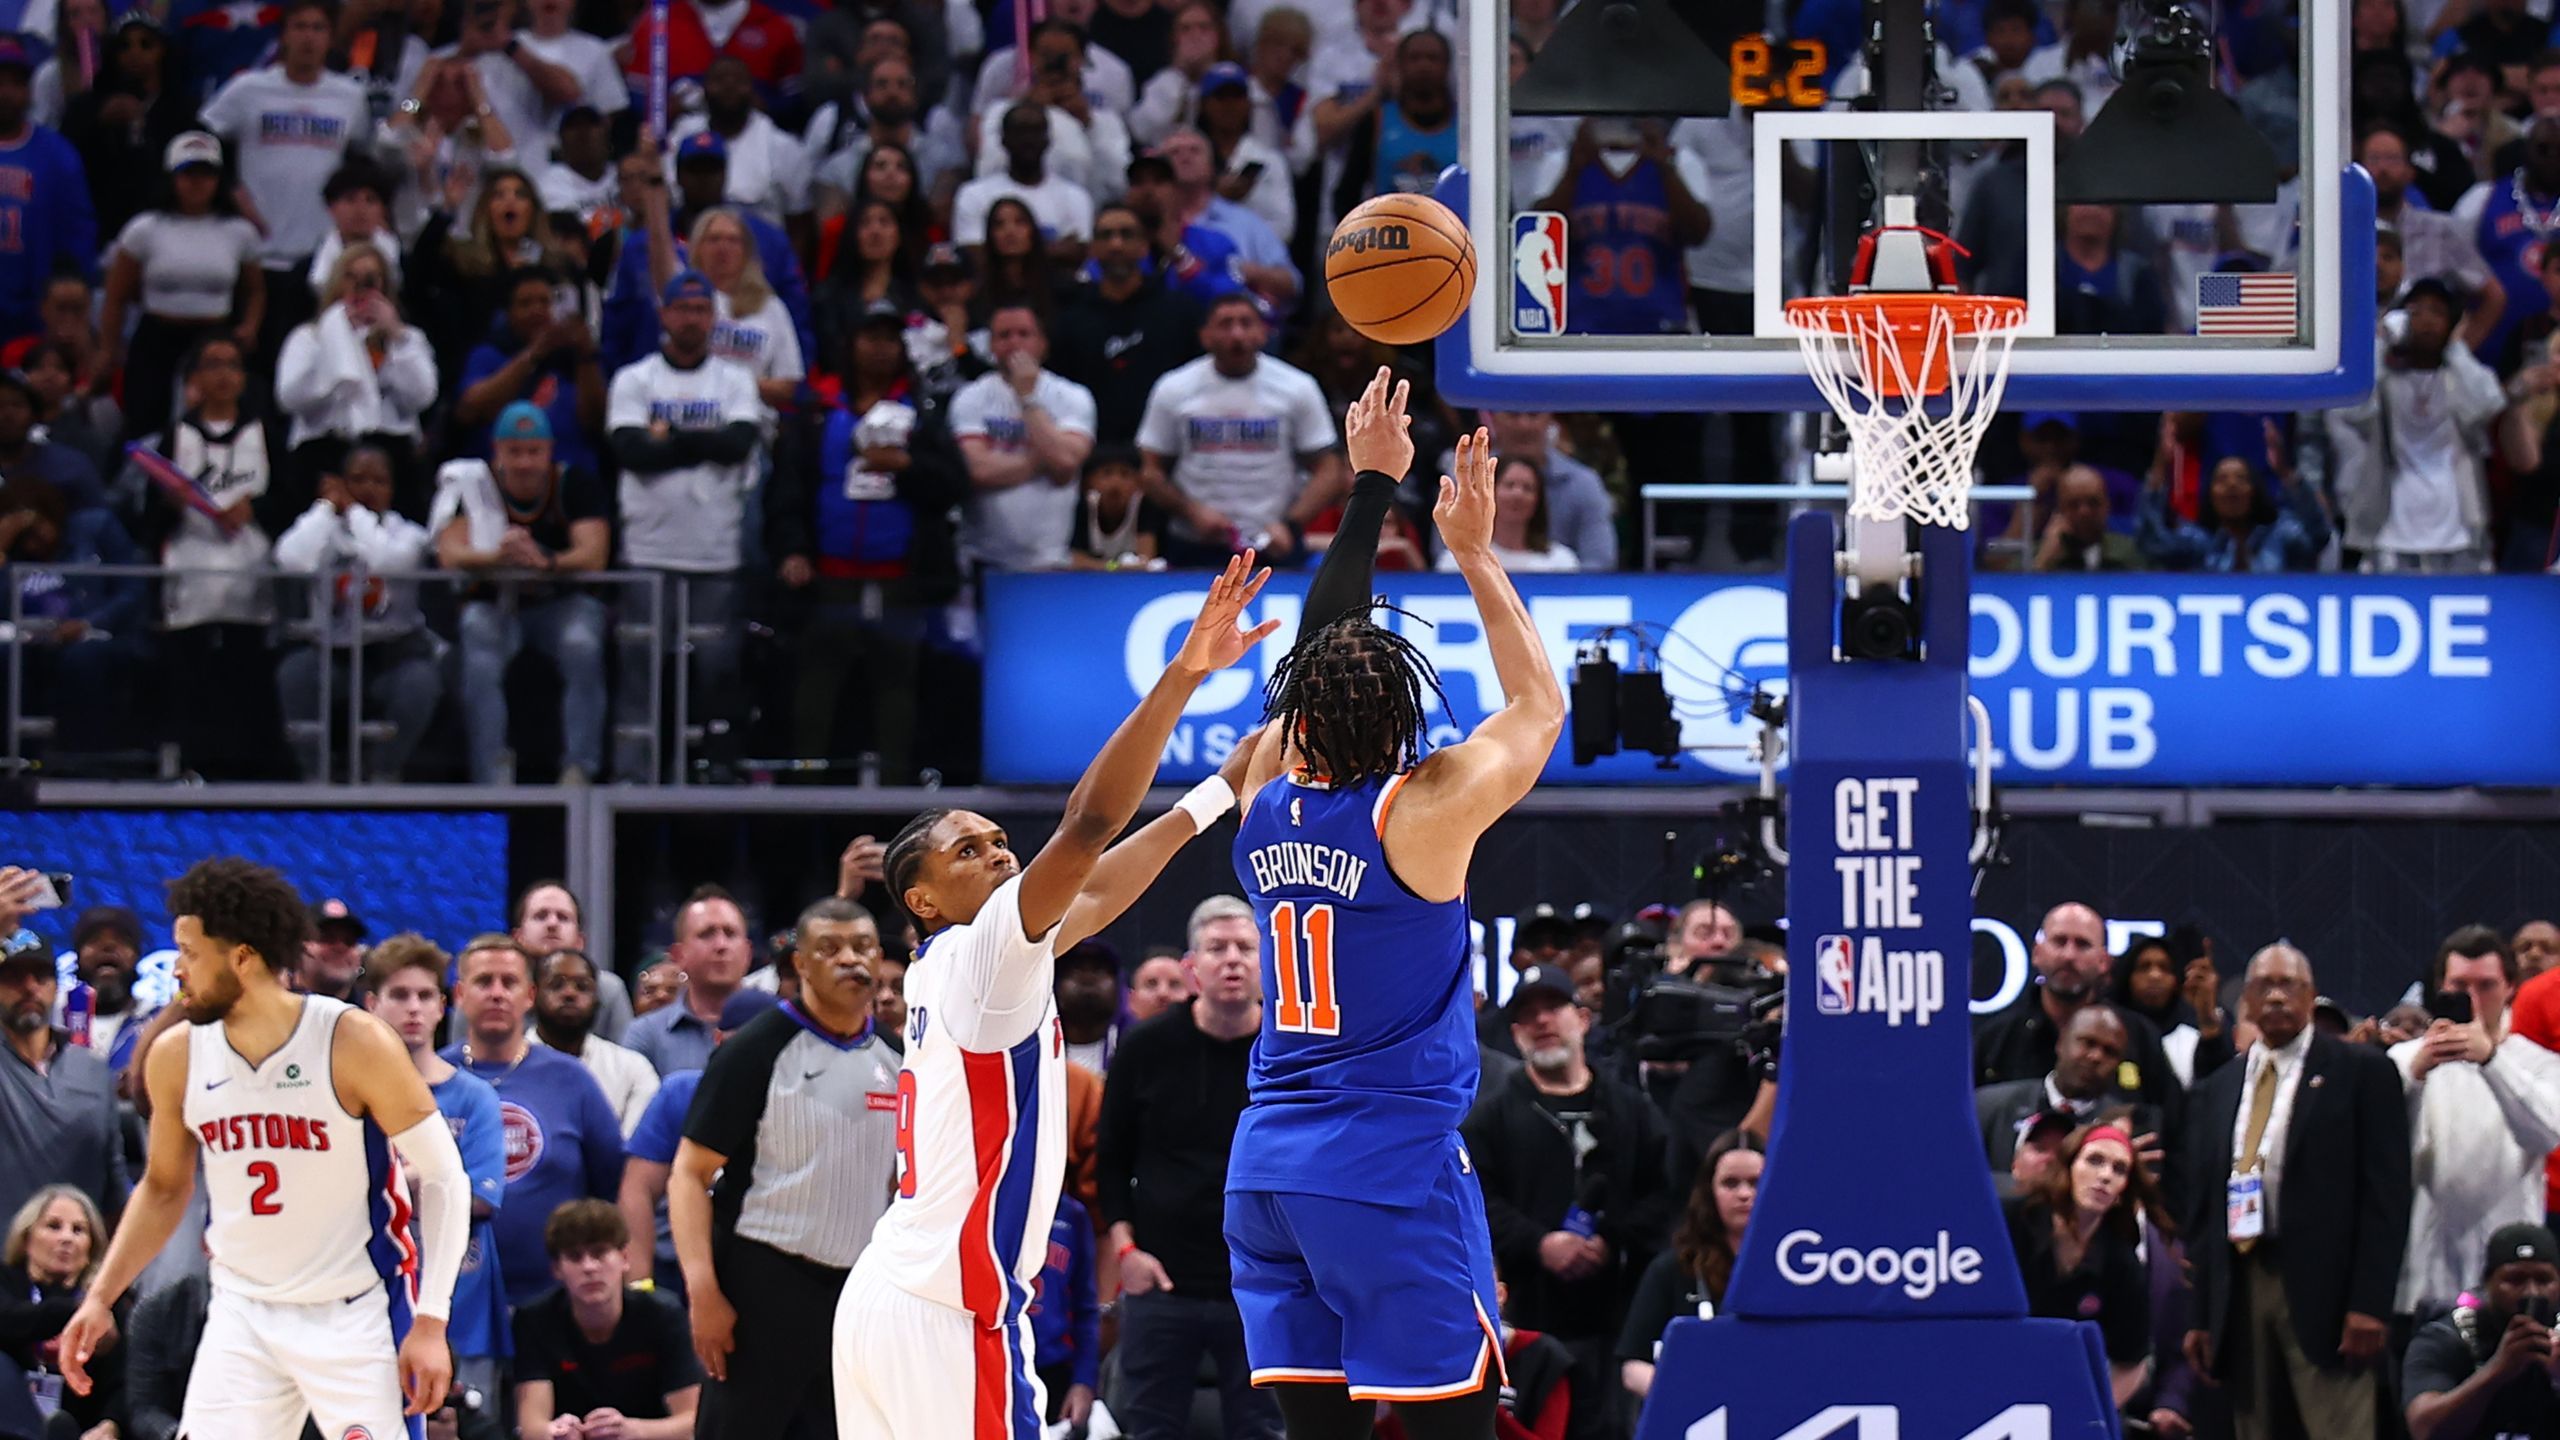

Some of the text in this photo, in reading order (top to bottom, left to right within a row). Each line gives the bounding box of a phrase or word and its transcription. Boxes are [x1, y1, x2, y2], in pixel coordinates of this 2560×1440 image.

[1328, 225, 1410, 258] Wilson
[1582, 244, 1656, 297] 30
[1968, 593, 2491, 678] OURTSIDE
[1968, 687, 2157, 769] UB
[1834, 778, 1919, 851] GET
[1249, 841, 1368, 901] BRUNSON
[1834, 855, 1923, 929] THE
[1270, 900, 1341, 1036] 11
[1857, 936, 1944, 1026] App
[198, 1113, 332, 1155] PISTONS
[247, 1160, 284, 1216] 2
[1775, 1229, 1984, 1299] Google
